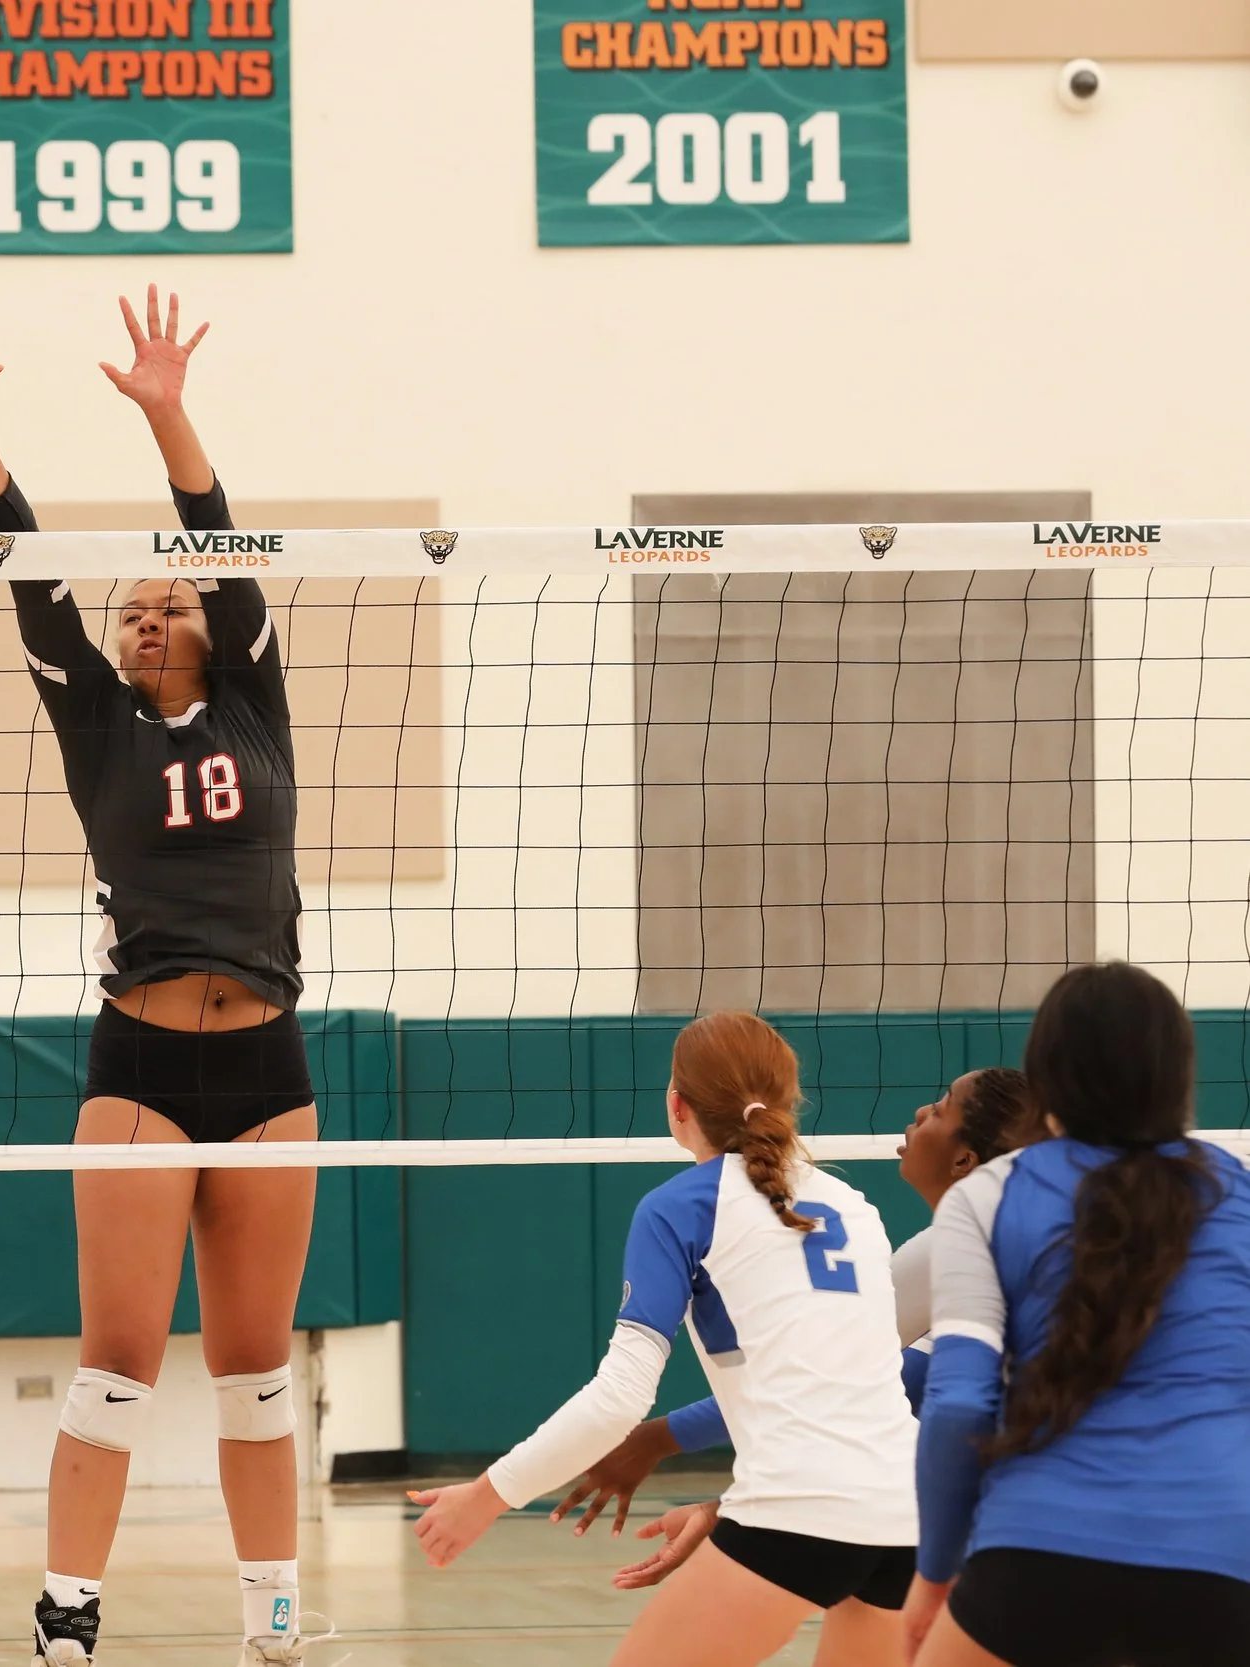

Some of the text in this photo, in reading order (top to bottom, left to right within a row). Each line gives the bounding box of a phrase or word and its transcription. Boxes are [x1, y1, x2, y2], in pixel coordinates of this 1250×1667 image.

[207, 0, 273, 38] III
[561, 19, 888, 69] CHAMPIONS
[587, 111, 846, 205] 2001
[166, 555, 271, 568] LEOPARDS
[608, 550, 711, 564] LEOPARDS
[1046, 545, 1149, 558] LEOPARDS
[162, 752, 244, 829] 18
[793, 1200, 859, 1293] 2
